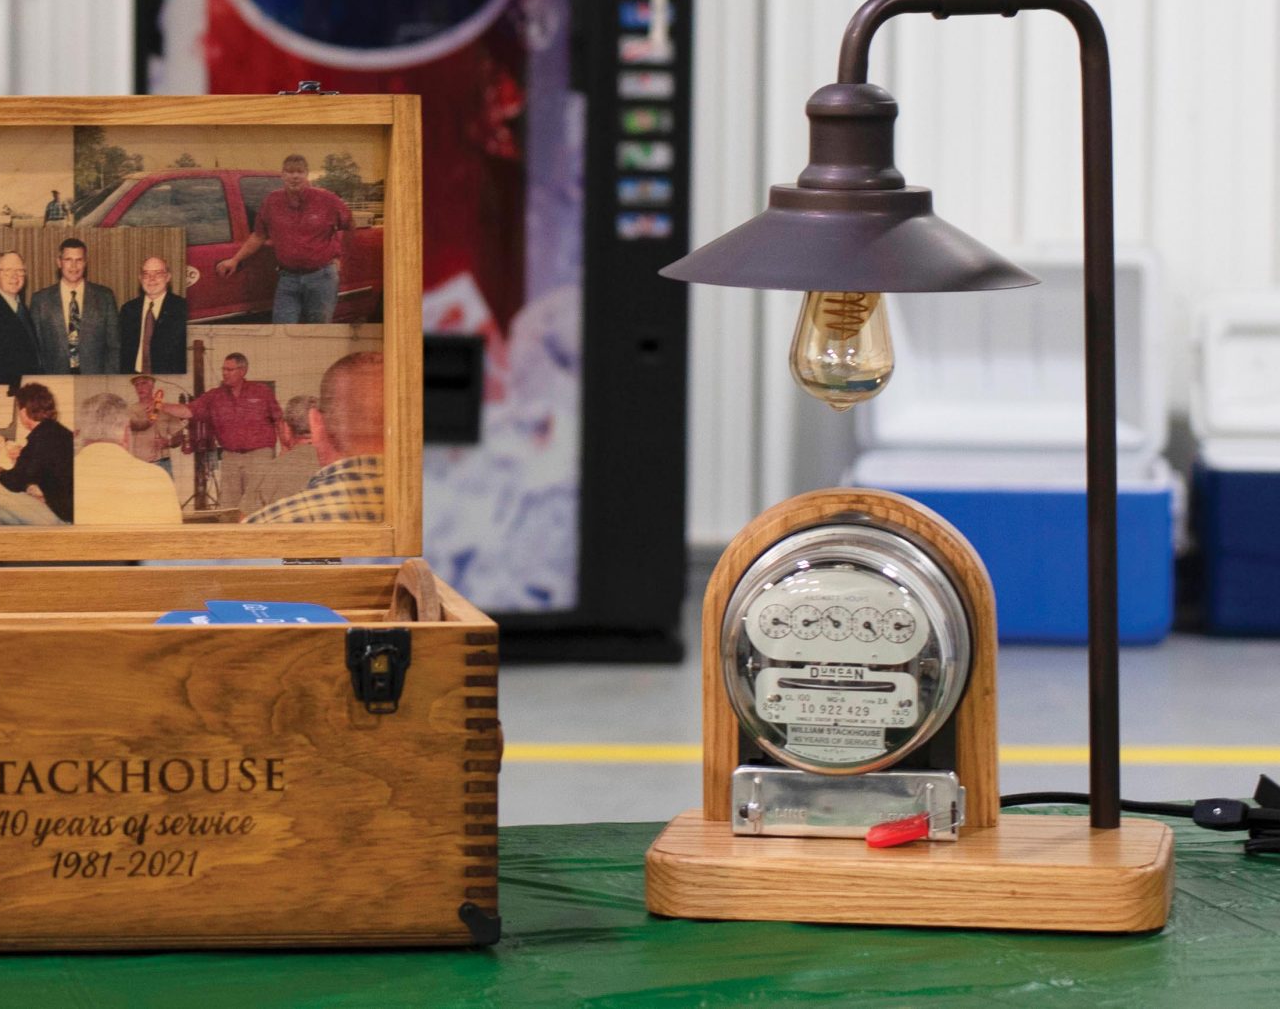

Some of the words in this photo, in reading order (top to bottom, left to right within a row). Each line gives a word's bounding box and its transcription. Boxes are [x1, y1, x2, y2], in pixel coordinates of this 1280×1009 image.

[810, 667, 864, 680] DUNCAN
[801, 703, 815, 714] 10
[819, 704, 842, 715] 922
[847, 705, 870, 717] 429
[790, 726, 824, 735] WILLIAM
[826, 727, 881, 738] STACKHOUSE
[32, 813, 117, 848] years
[122, 812, 150, 846] of
[155, 811, 258, 837] service
[51, 850, 200, 879] 1981-2021
